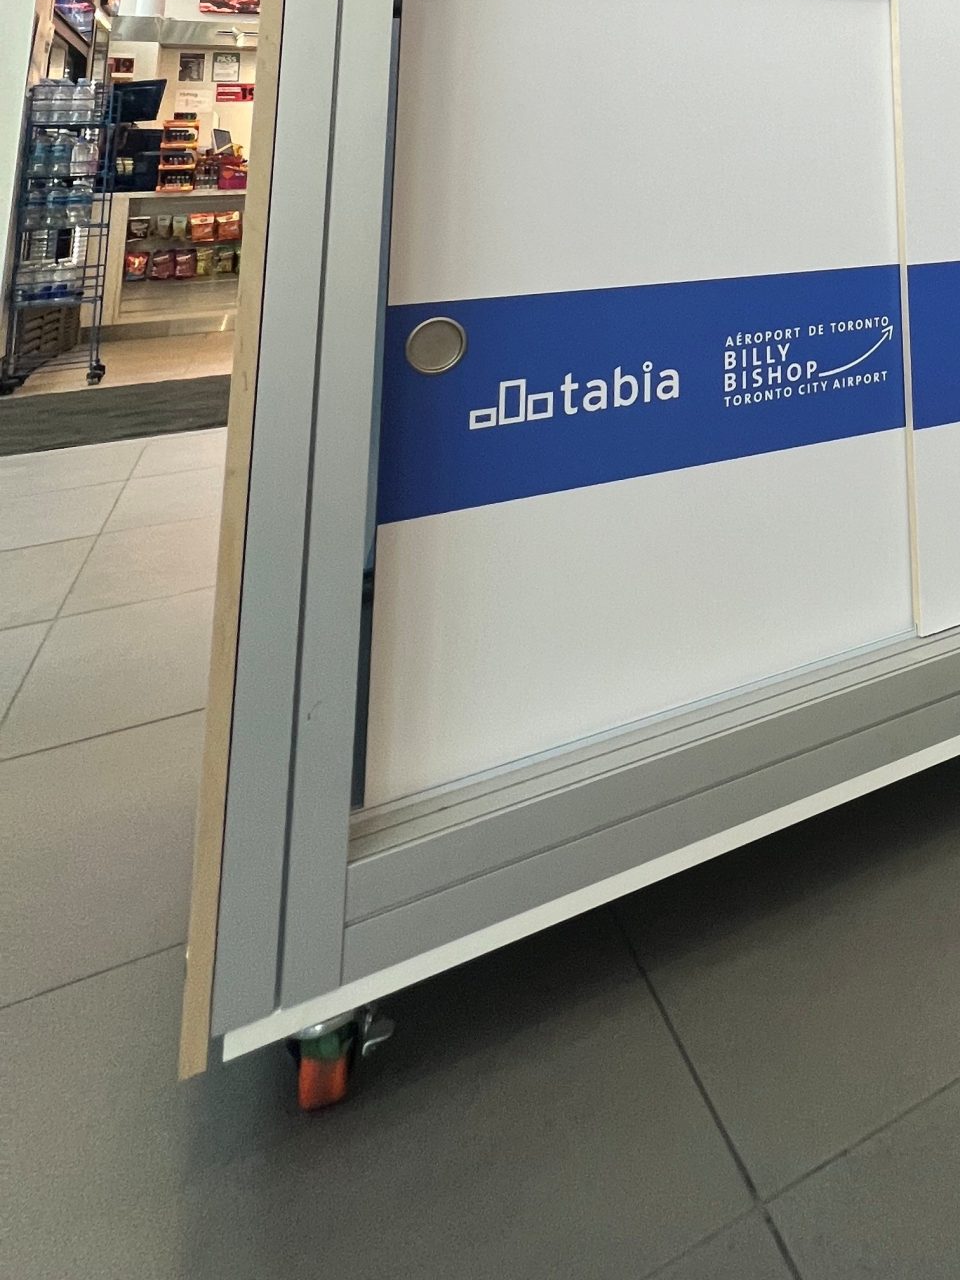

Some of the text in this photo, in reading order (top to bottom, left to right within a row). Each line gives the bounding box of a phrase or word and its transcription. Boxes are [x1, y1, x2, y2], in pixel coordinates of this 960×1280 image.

[725, 315, 889, 348] AÉROPORT DE TORONTO
[724, 342, 790, 370] BILLY
[560, 361, 680, 415] tabia
[724, 360, 817, 392] BISHOP
[724, 371, 888, 408] TORONTO CITY AIRPORT
